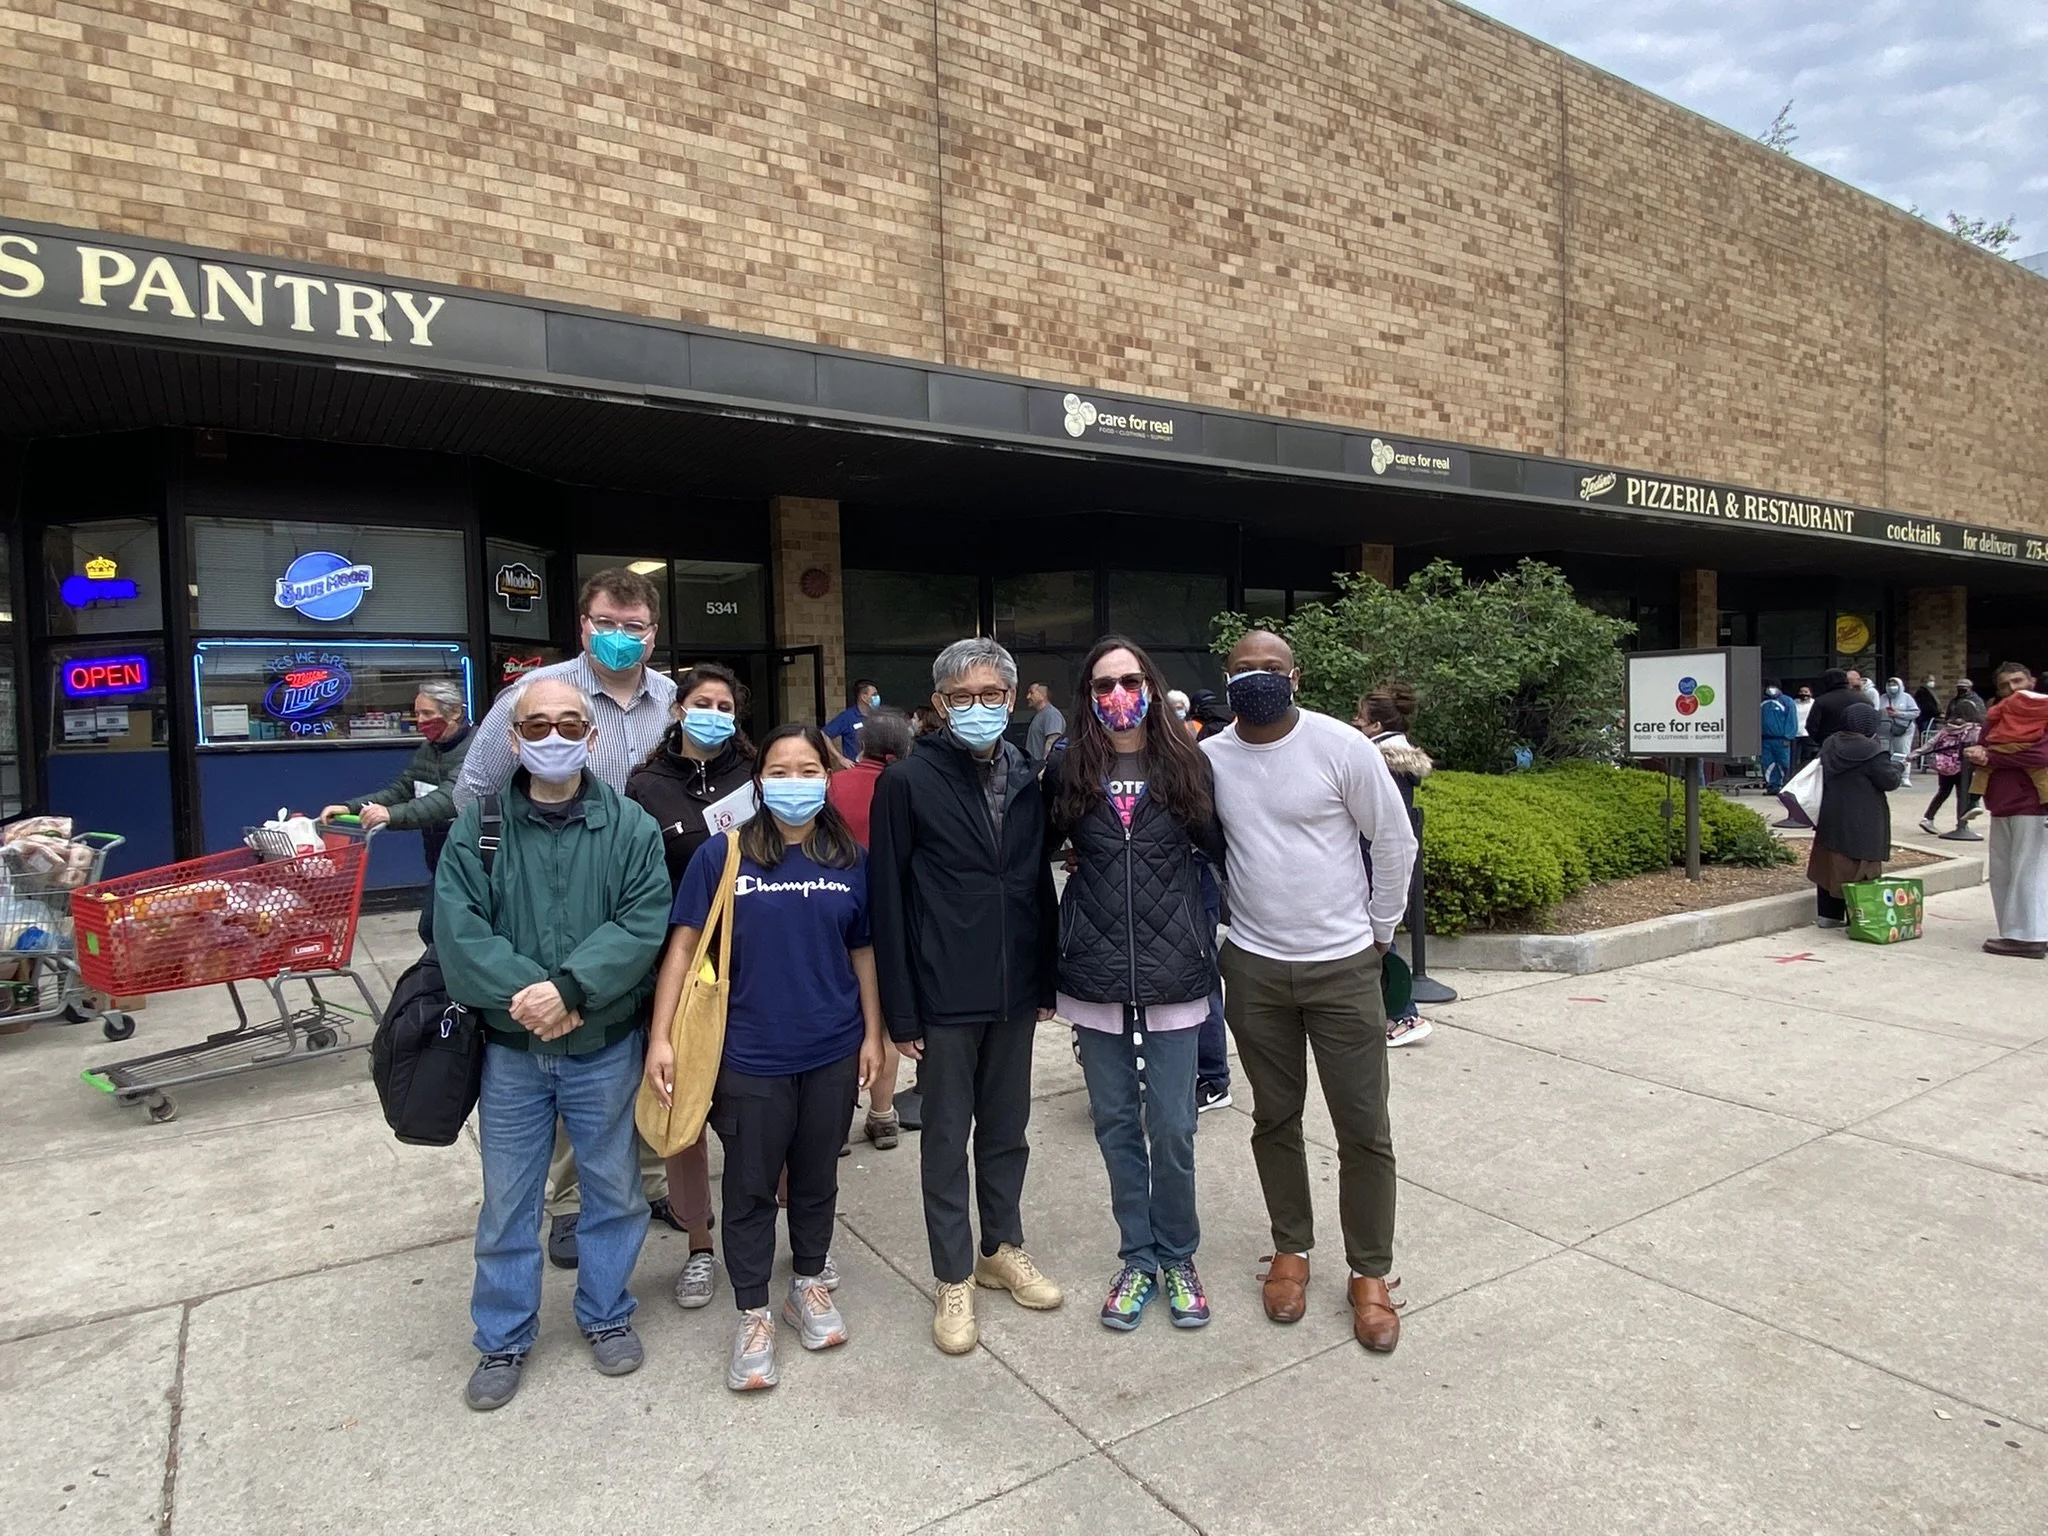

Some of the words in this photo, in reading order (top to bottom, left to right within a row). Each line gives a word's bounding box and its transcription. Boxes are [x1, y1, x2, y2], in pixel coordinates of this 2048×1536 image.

[76, 246, 446, 347] PANTRY
[1098, 413, 1126, 428] care
[1129, 414, 1147, 431] for
[1149, 420, 1174, 435] real
[1395, 453, 1416, 466] care
[1417, 453, 1431, 467] for
[1432, 457, 1450, 470] real
[1626, 477, 1720, 516] PIZZERIA
[1724, 492, 1740, 518] &
[1744, 494, 1854, 533] RESTAURANT
[1887, 520, 1941, 546] cocktails
[1963, 529, 1978, 551] for
[1979, 532, 2018, 558] delivery
[280, 582, 325, 606] BLUE
[326, 569, 369, 592] MOON
[504, 569, 535, 589] Modelo
[706, 602, 738, 615] 5341
[268, 655, 294, 672] YES
[295, 651, 317, 664] WE
[319, 653, 348, 669] ARE
[71, 663, 142, 689] OPEN
[281, 677, 340, 715] Lite
[290, 720, 335, 736] OPEN
[1633, 721, 1666, 732] care
[1669, 718, 1691, 732] for
[1694, 718, 1725, 732] real
[734, 875, 851, 898] Champion
